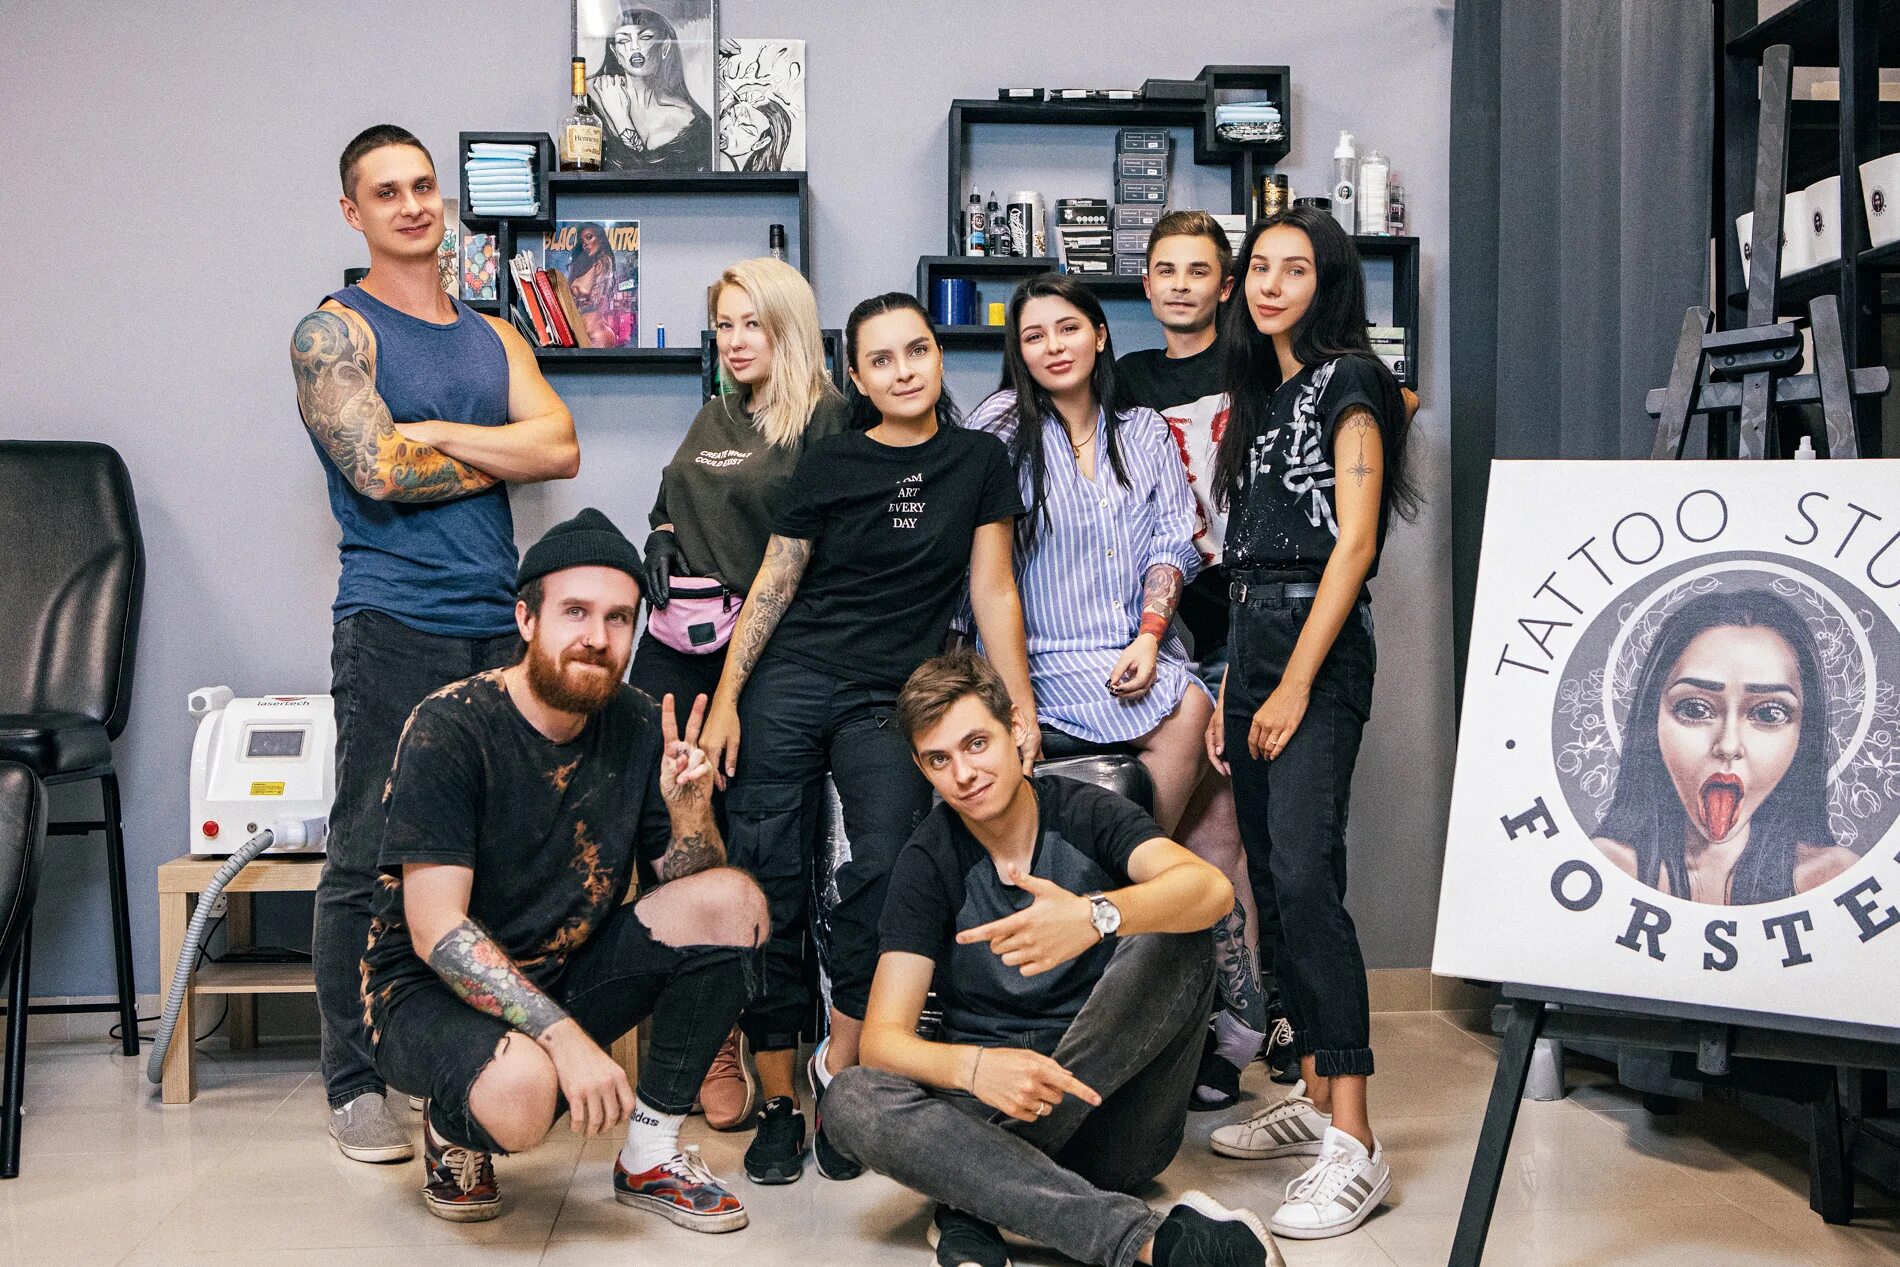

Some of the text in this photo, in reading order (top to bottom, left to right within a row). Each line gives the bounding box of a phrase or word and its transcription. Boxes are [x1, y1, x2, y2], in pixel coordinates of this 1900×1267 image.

[544, 227, 578, 251] BLAC
[699, 449, 753, 459] CREATE WHAT
[694, 456, 723, 467] COULD
[897, 487, 921, 498] ART
[887, 502, 926, 513] EVERY
[892, 517, 918, 529] DAY
[1495, 488, 1900, 676] TATTOO STU
[1499, 795, 1900, 972] FORSTE
[630, 1108, 660, 1127] idas
